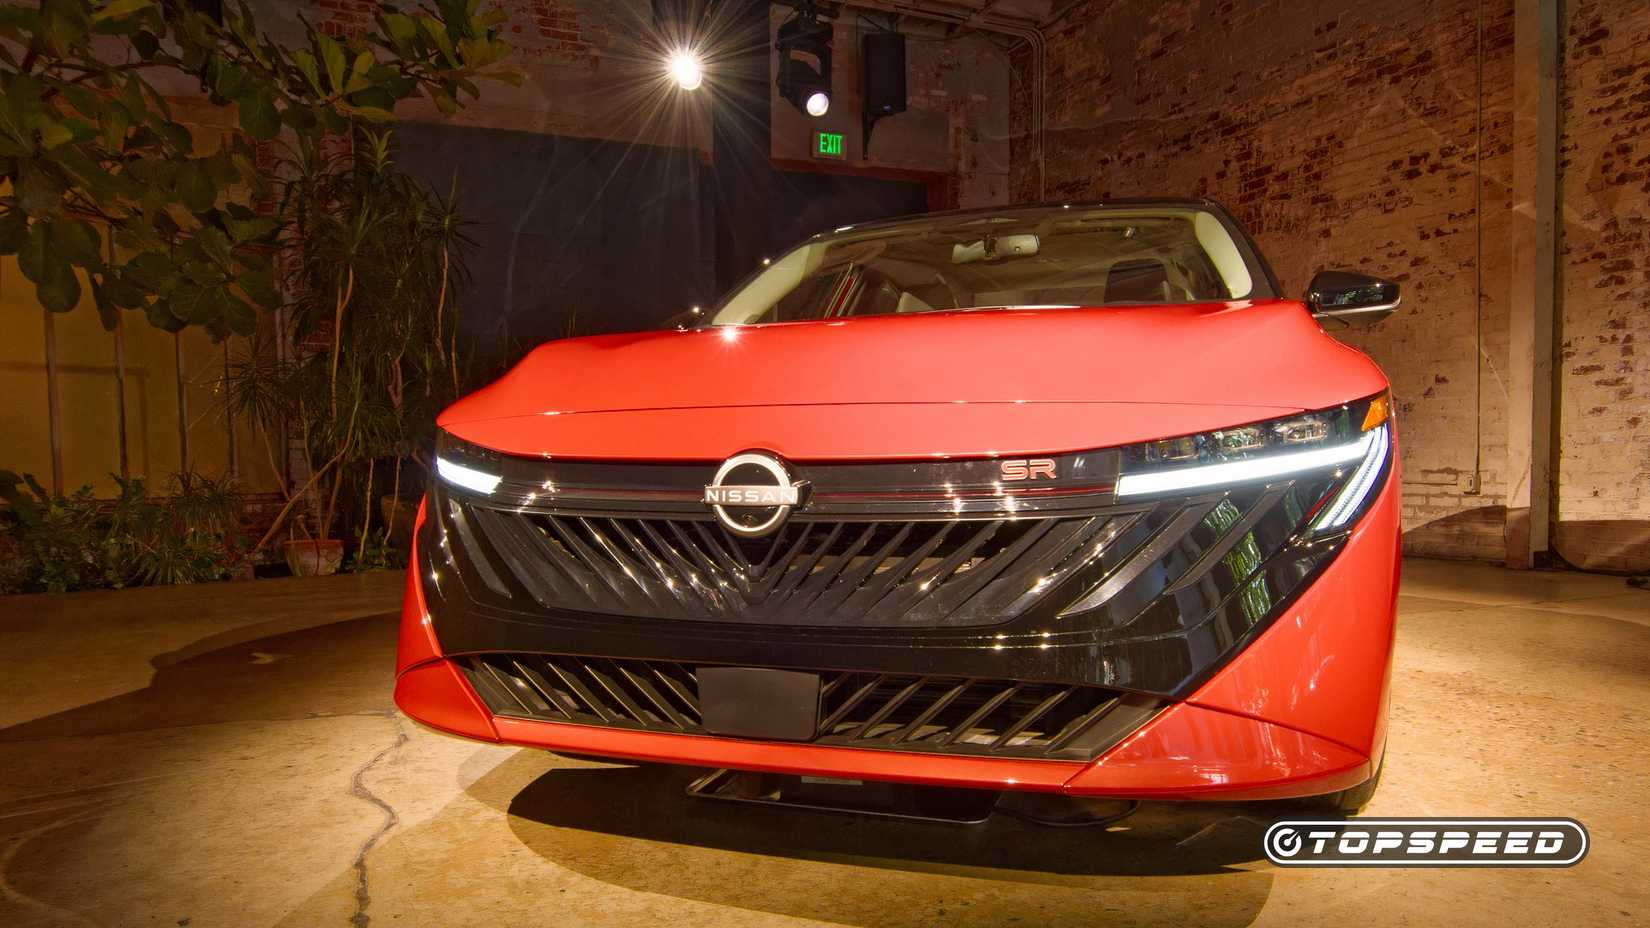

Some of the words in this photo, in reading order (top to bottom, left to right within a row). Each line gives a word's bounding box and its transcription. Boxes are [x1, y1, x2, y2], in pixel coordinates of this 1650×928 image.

[820, 133, 843, 154] EXIT
[1001, 459, 1056, 480] SR
[706, 489, 796, 503] NISSAN
